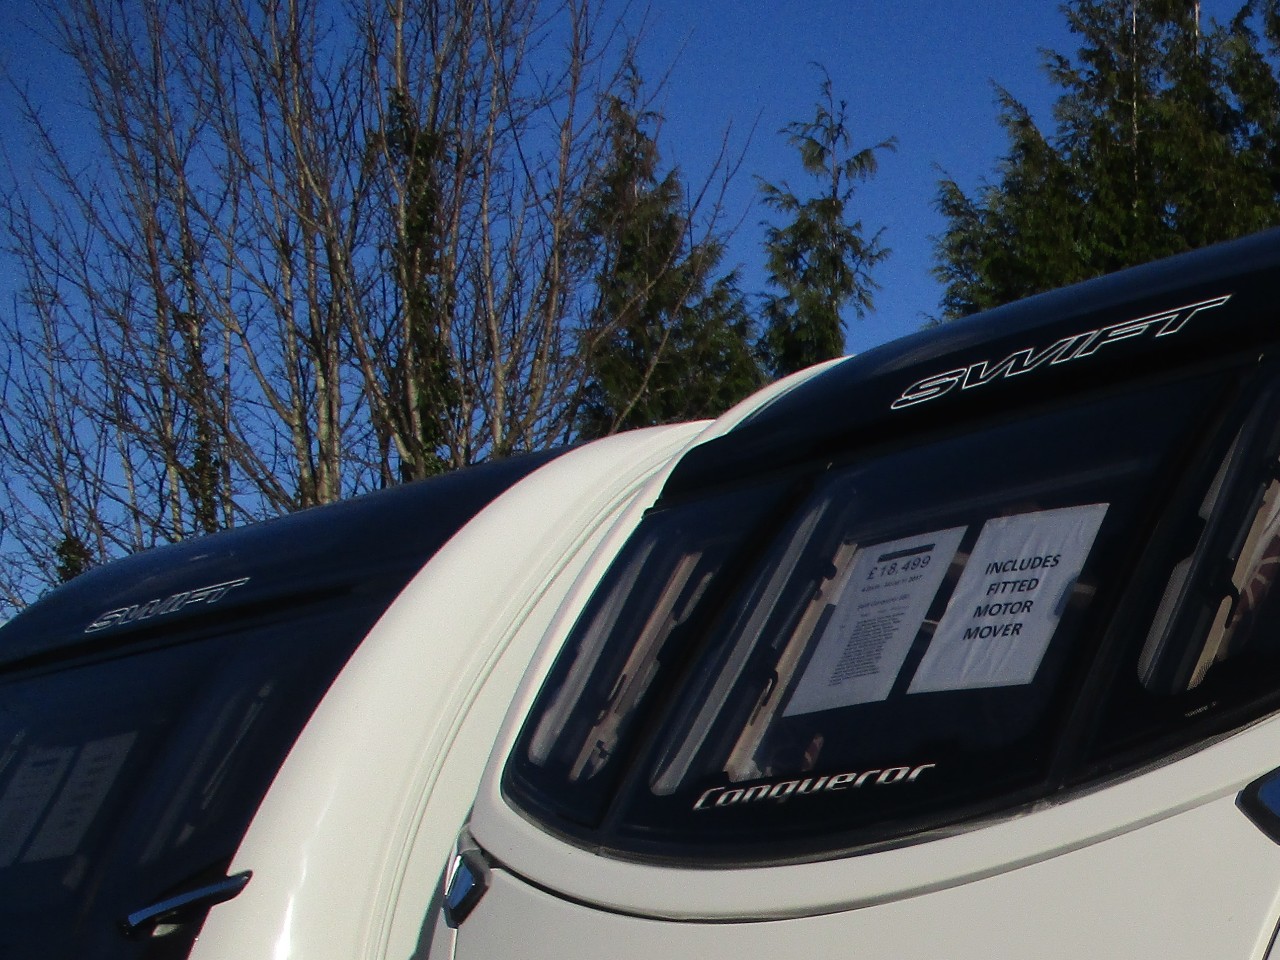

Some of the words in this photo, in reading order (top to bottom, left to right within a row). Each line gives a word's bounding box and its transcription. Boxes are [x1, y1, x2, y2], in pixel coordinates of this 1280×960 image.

[890, 293, 1232, 410] SWIFT
[985, 554, 1062, 575] INCLUDES
[986, 578, 1040, 596] FITTED
[84, 576, 251, 633] SWIFT
[973, 600, 1034, 618] MOTOR
[962, 623, 1023, 640] MOVER
[692, 763, 936, 811] Conqueror
